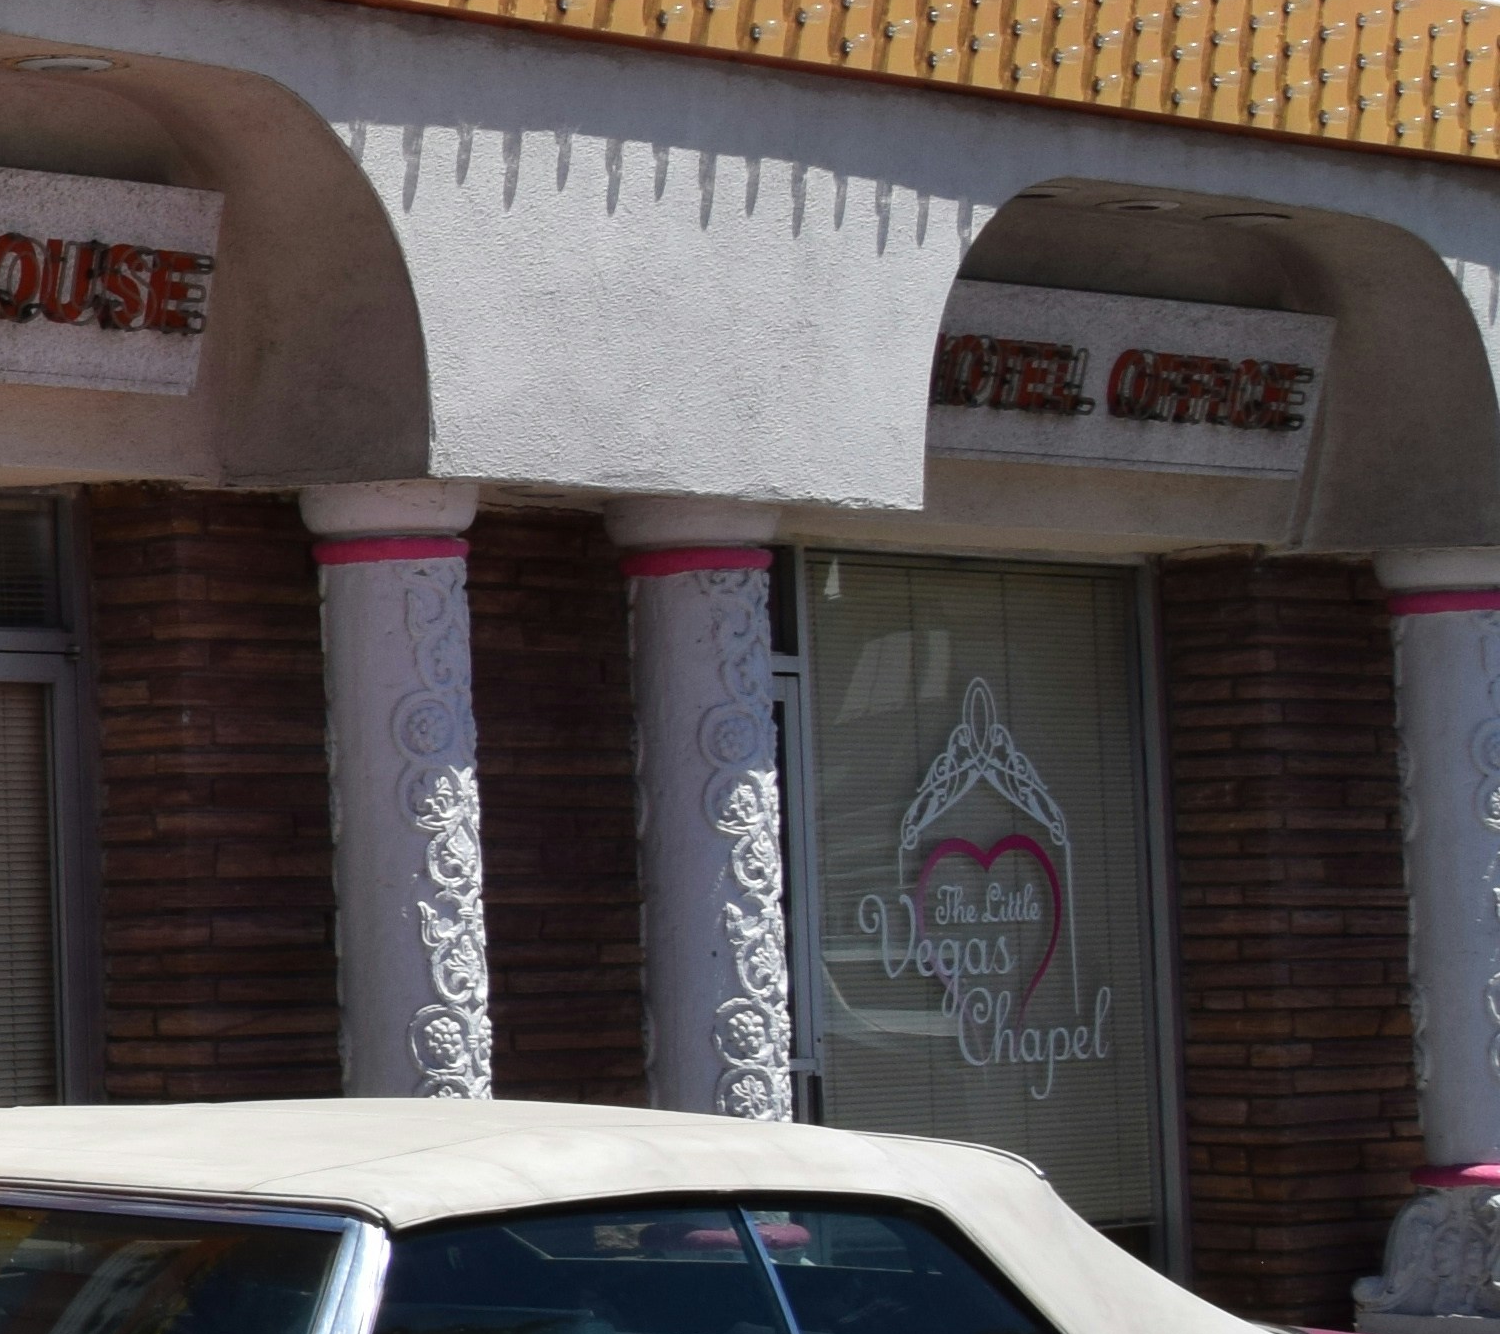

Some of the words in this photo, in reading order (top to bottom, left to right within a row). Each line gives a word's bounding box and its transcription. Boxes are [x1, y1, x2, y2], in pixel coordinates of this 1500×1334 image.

[1107, 349, 1314, 431] OFFICE
[935, 884, 977, 925] The
[981, 882, 1041, 922] Little
[858, 894, 1017, 1017] Vegas
[958, 986, 1111, 1100] Chapel
